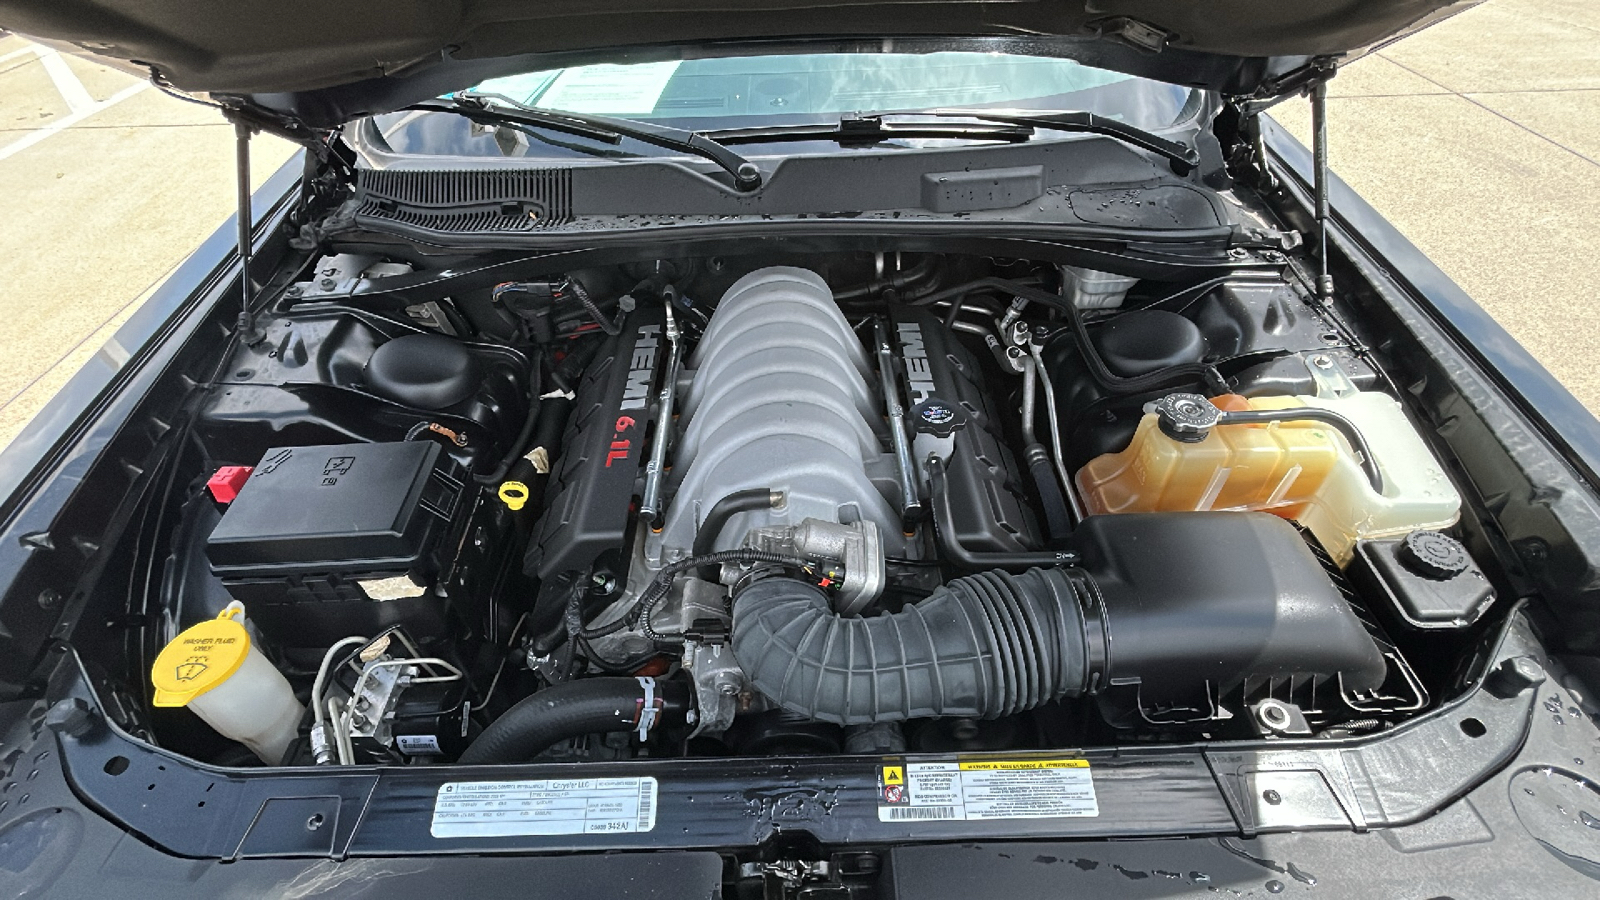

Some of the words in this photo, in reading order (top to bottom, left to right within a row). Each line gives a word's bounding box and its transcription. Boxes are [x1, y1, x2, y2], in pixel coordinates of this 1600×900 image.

[619, 324, 662, 411] HEMI
[605, 416, 636, 468] 6.1L
[183, 637, 213, 645] WASHER
[214, 637, 236, 645] FLUID
[552, 781, 578, 791] Chrysler
